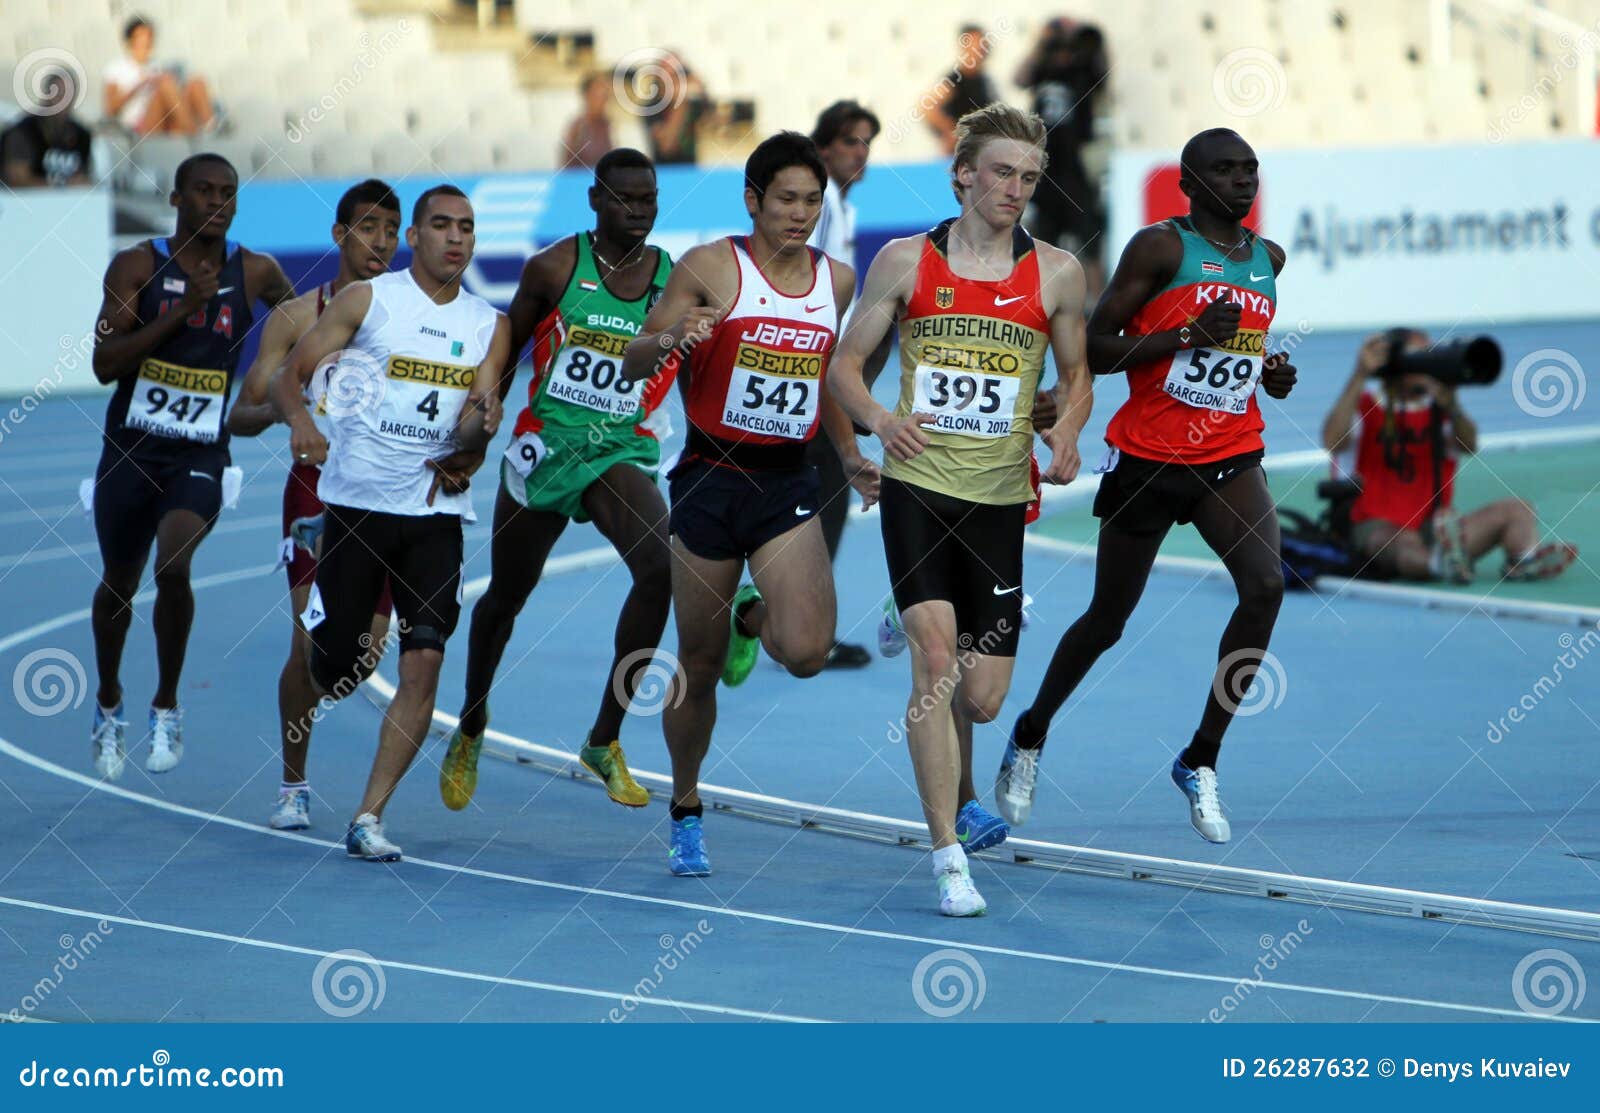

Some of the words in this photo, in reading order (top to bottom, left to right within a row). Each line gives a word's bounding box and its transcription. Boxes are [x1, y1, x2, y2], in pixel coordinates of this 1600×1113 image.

[1293, 199, 1570, 273] Ajuntament
[1195, 285, 1270, 319] KENYA
[911, 317, 1034, 350] DEUTSCHLAND
[1221, 332, 1263, 353] IKO
[390, 359, 475, 388] SEIKO
[565, 350, 635, 394] 808
[739, 347, 820, 377] SEIKO
[922, 345, 1019, 374] SEIKO
[1184, 350, 1253, 392] 569
[143, 361, 225, 393] SEIKO
[146, 387, 212, 424] 947
[416, 390, 439, 422] 4
[550, 382, 612, 411] BARCELONA
[742, 375, 809, 416] 542
[929, 371, 1001, 414] 395
[1166, 382, 1226, 409] BARCELONA
[130, 416, 189, 439] BARCELONA
[380, 420, 441, 441] BARCELONA
[726, 410, 791, 435] BARCELONA
[932, 413, 981, 432] CELONA
[986, 420, 1009, 433] 2012
[520, 443, 537, 469] 9
